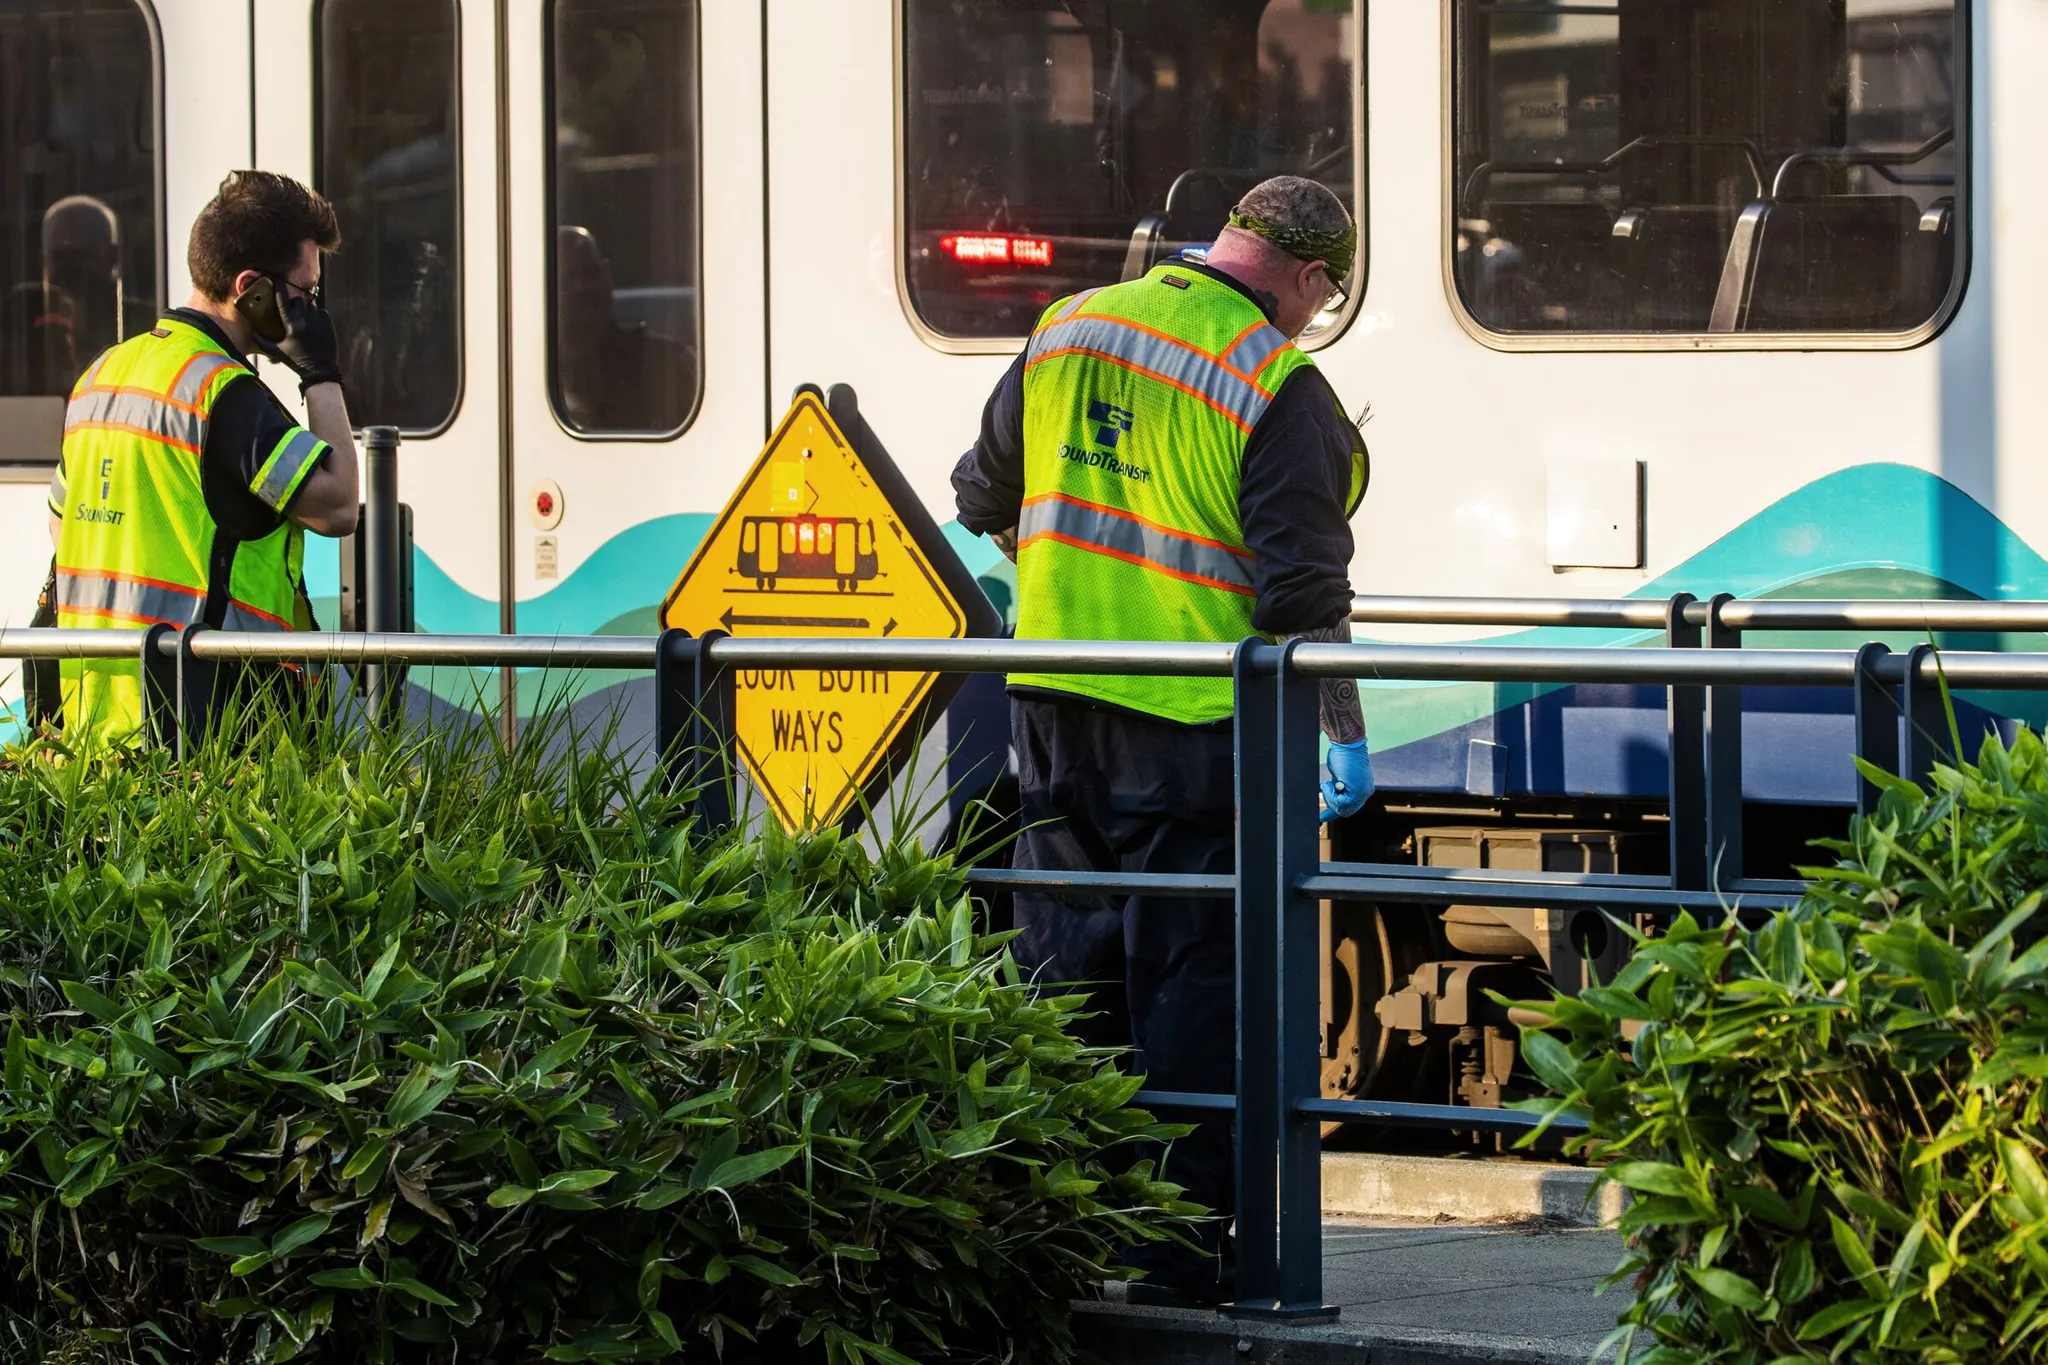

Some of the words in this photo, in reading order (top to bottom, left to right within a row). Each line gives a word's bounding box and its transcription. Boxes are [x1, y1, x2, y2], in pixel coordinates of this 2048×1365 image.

[1057, 441, 1150, 483] OUNDTRANSIT
[736, 670, 795, 691] OOK
[819, 670, 889, 694] BOTH
[772, 709, 843, 754] WAYS
